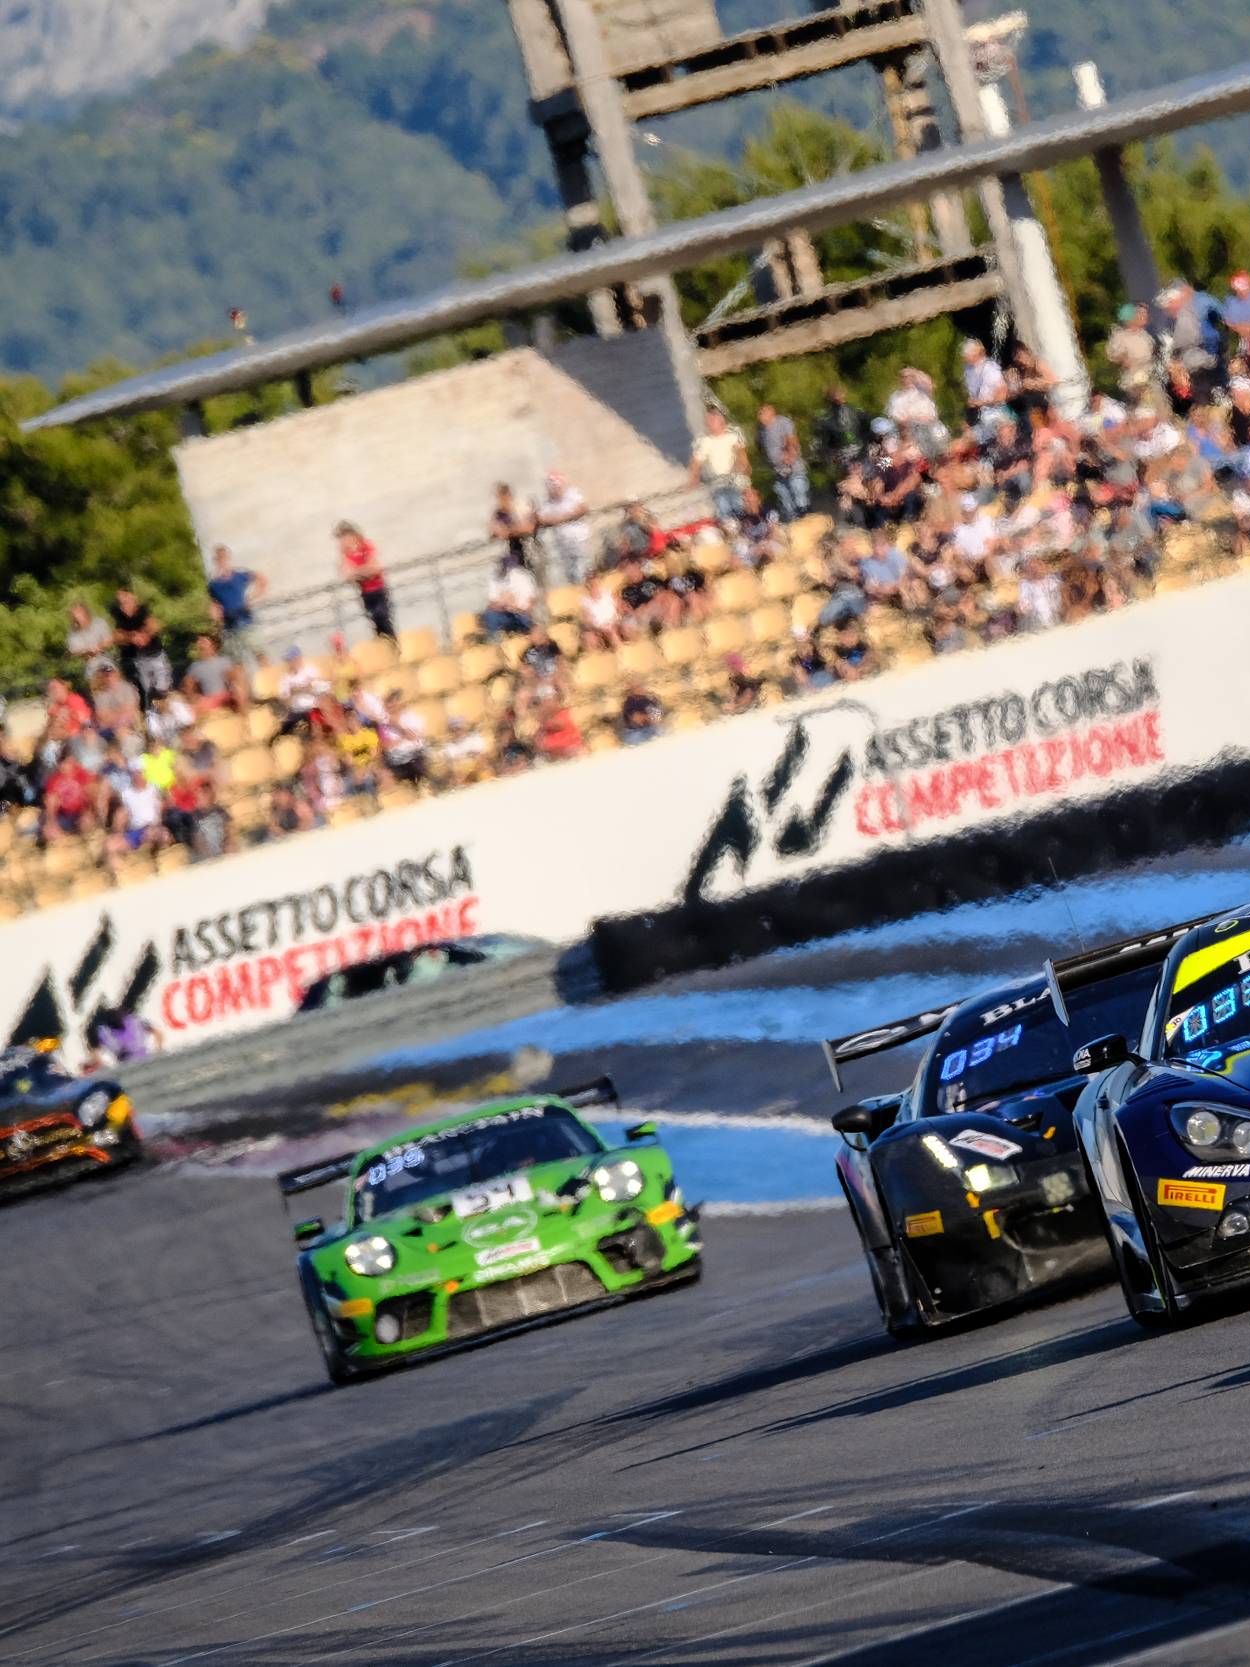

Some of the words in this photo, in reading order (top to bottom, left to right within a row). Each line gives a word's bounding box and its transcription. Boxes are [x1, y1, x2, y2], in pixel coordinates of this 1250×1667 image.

[864, 690, 1027, 778] ASSETTO
[1031, 654, 1162, 736] CORSA
[853, 711, 1165, 838] COMPETIZIONE
[168, 883, 339, 974] ASSETTO
[346, 844, 474, 924] CORSA
[940, 1023, 1022, 1080] 034
[1164, 1184, 1217, 1204] PIRELLI
[1182, 1163, 1250, 1179] MINERVA
